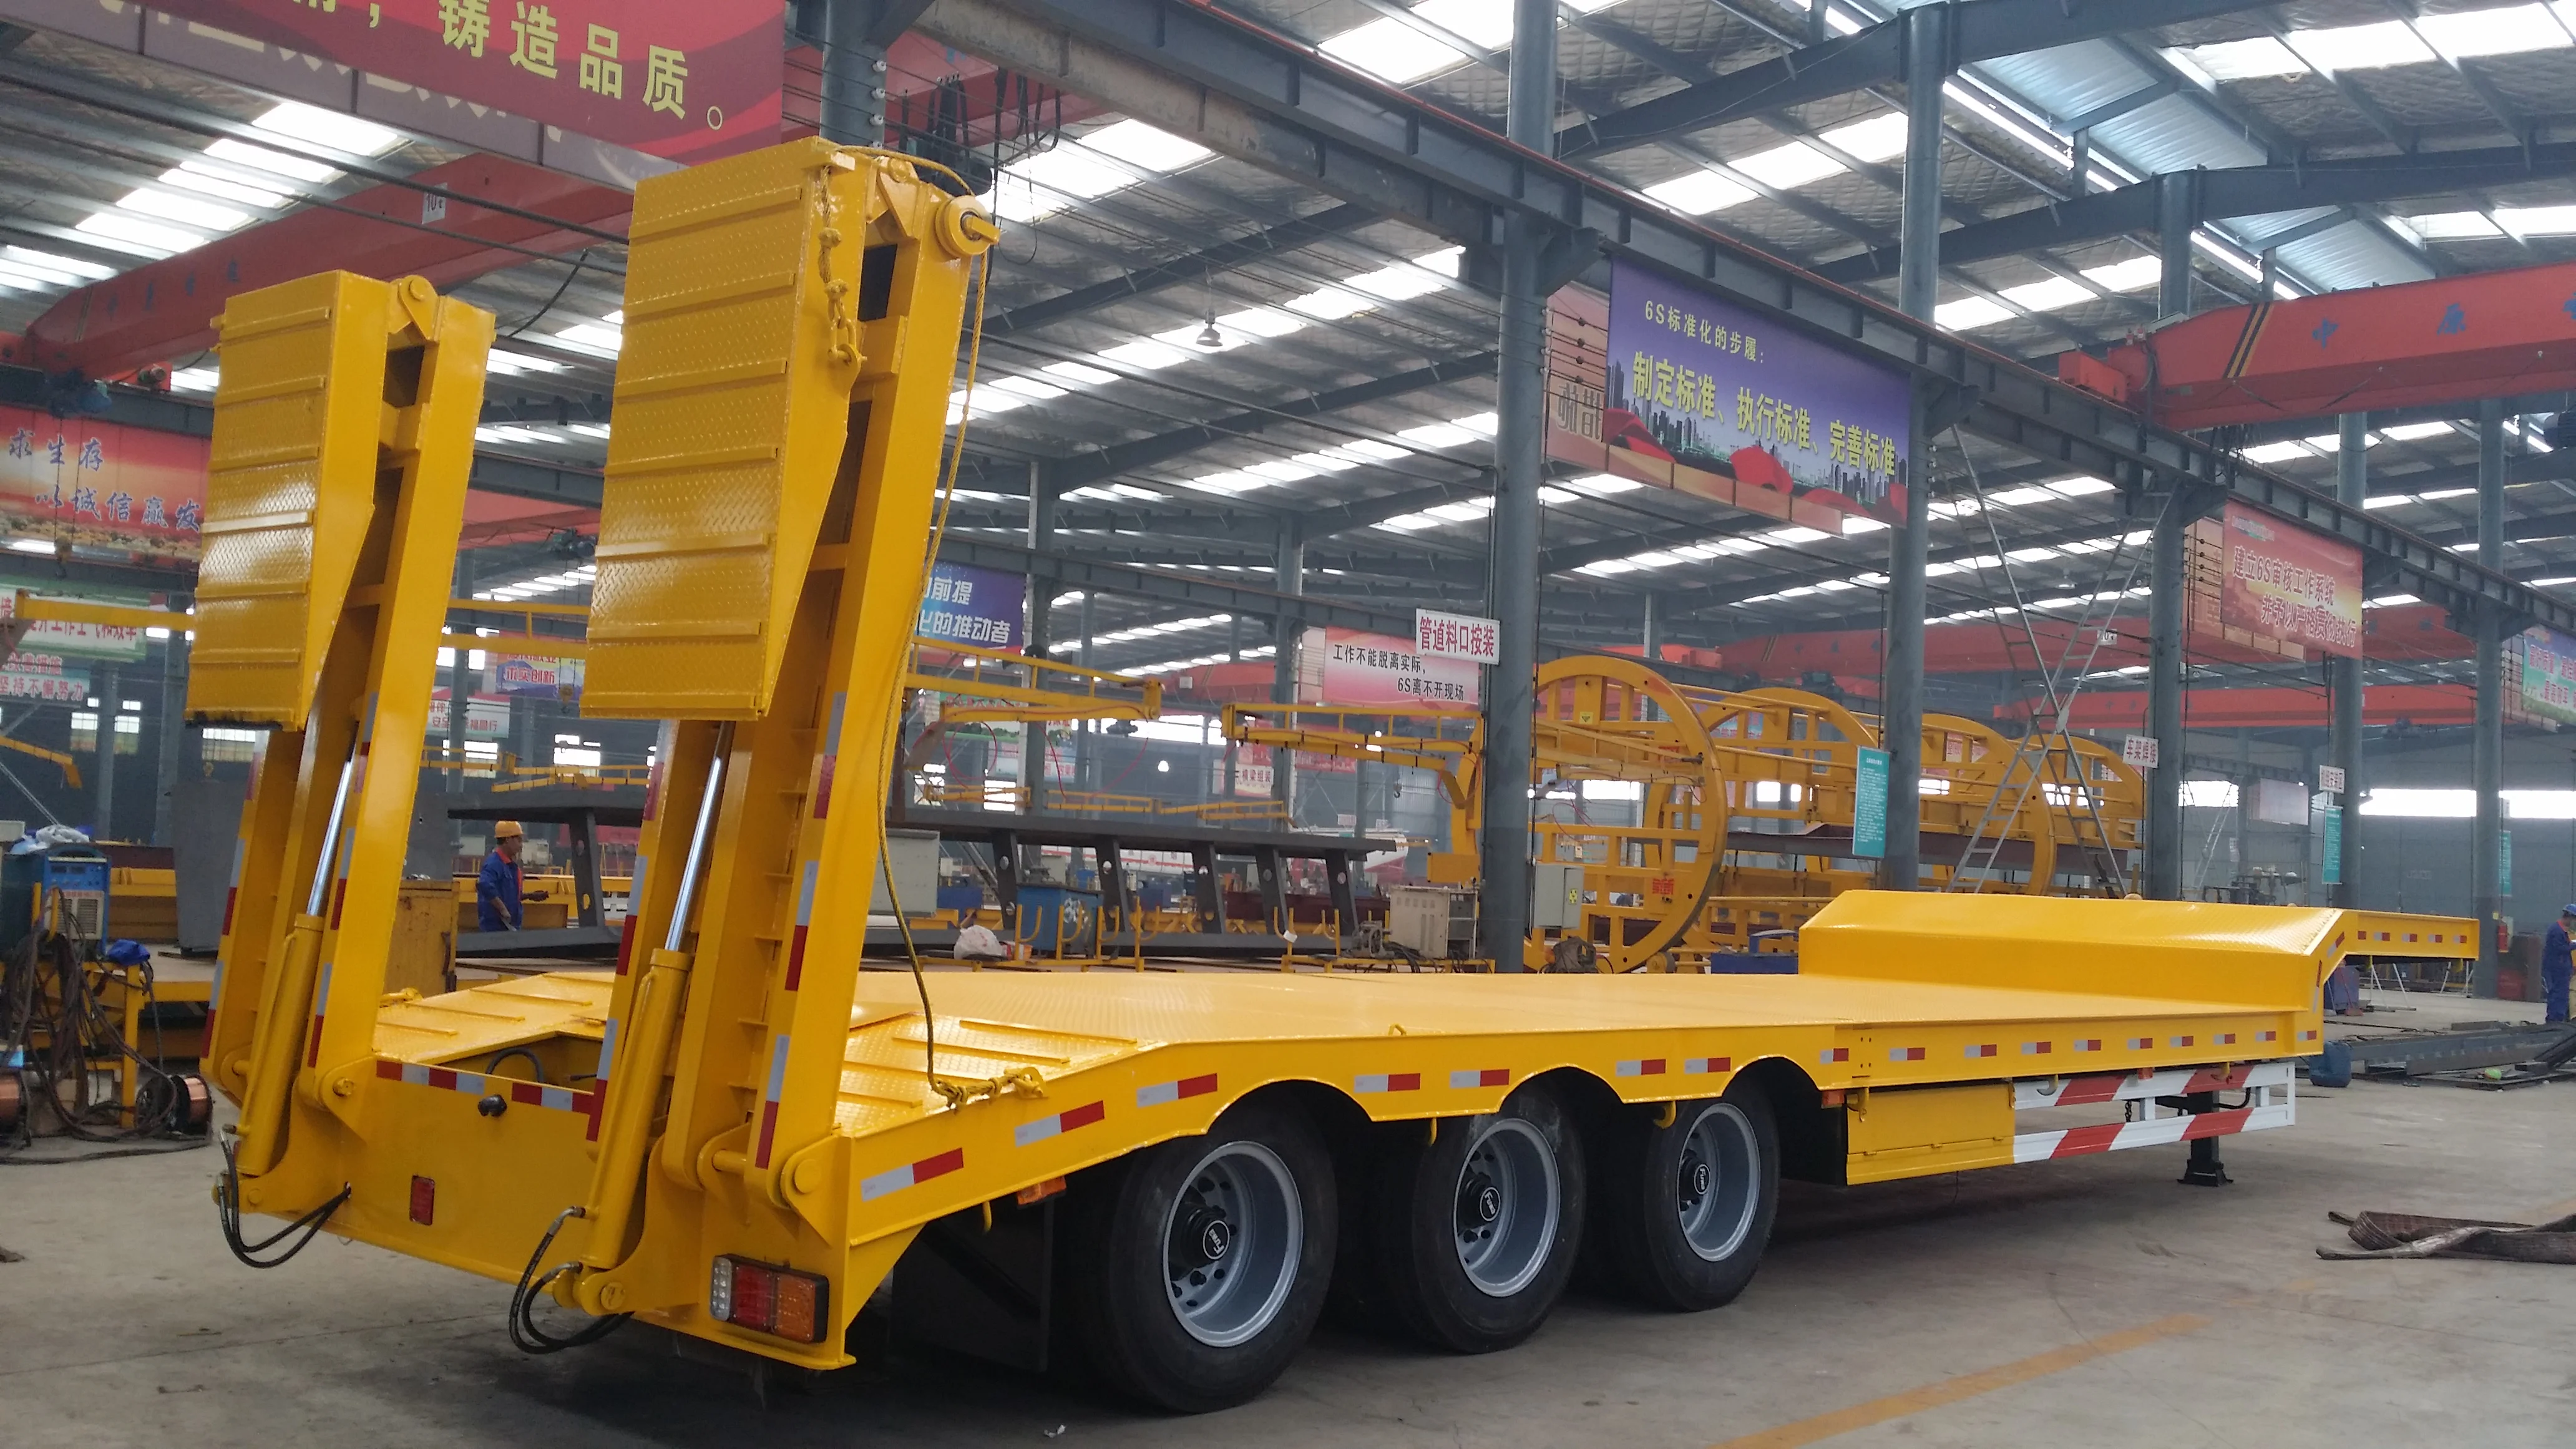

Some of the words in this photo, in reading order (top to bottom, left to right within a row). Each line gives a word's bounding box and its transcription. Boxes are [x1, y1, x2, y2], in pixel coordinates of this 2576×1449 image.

[1645, 300, 1765, 364] 6S标准化的步履：
[1633, 351, 1895, 477] 制定标准、执行标准、完善标准
[9, 428, 104, 472] 求生存
[2233, 545, 2335, 606] 建立6S审核工作系统
[1419, 615, 1495, 657] 管道料口按装
[2261, 593, 2357, 648] 并予以严格贯彻执行
[1333, 643, 1425, 675] 工作不能脱离实际，
[1397, 677, 1465, 701] 6S离不开现场
